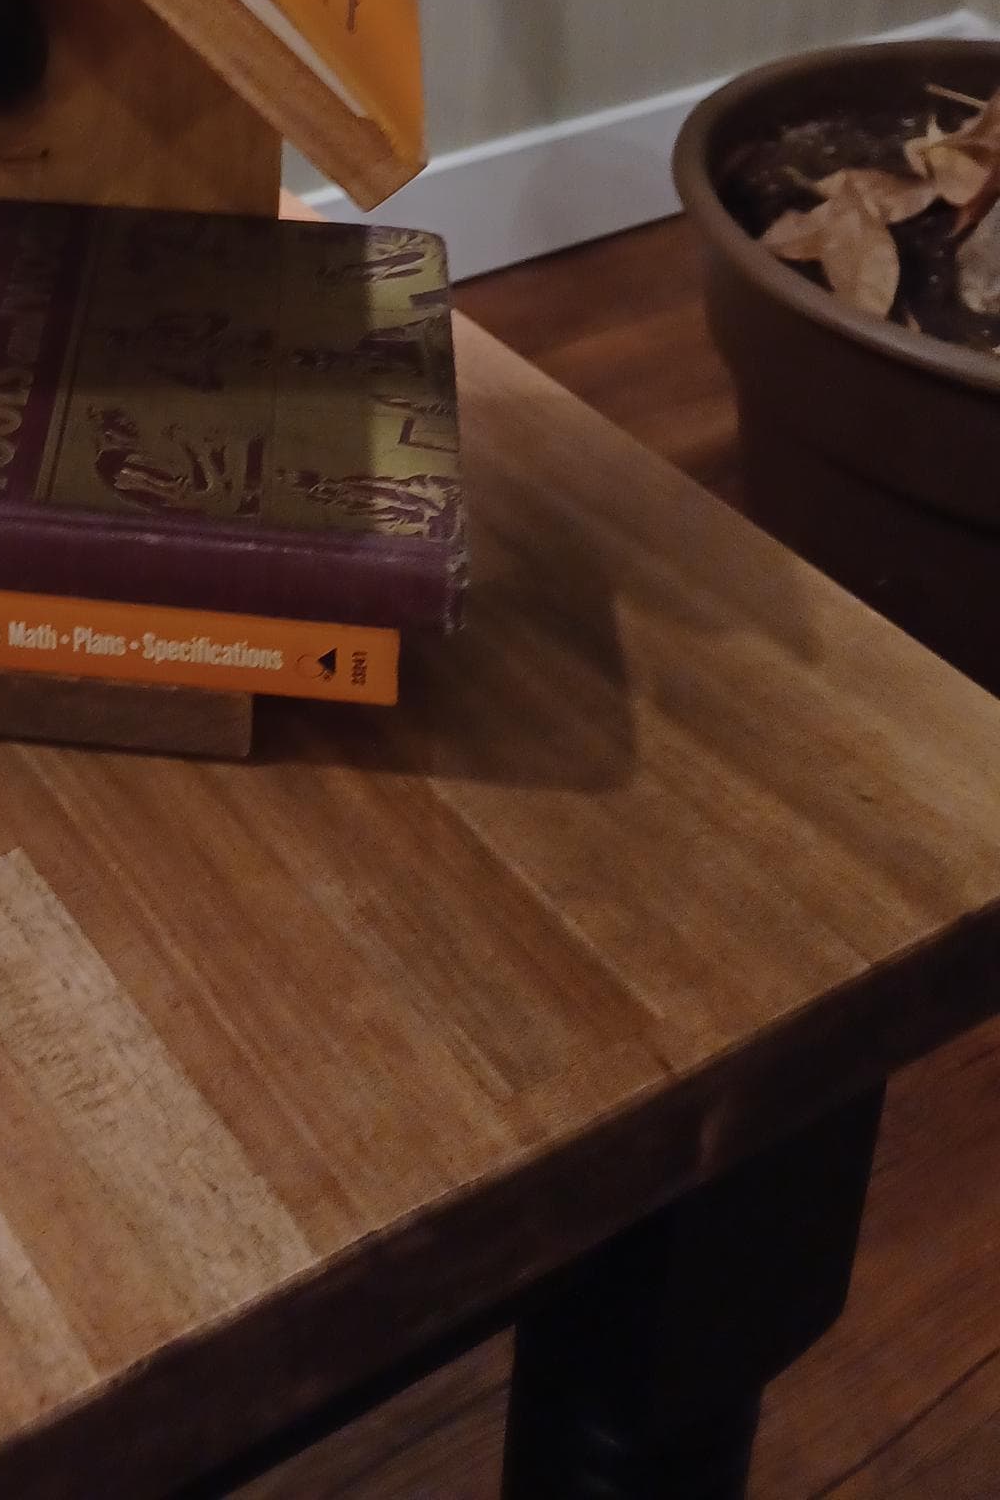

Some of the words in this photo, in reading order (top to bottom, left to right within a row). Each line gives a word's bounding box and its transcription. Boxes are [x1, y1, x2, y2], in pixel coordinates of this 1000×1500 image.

[8, 620, 57, 650] Math
[72, 626, 126, 657] Plans
[142, 631, 284, 671] Specifications
